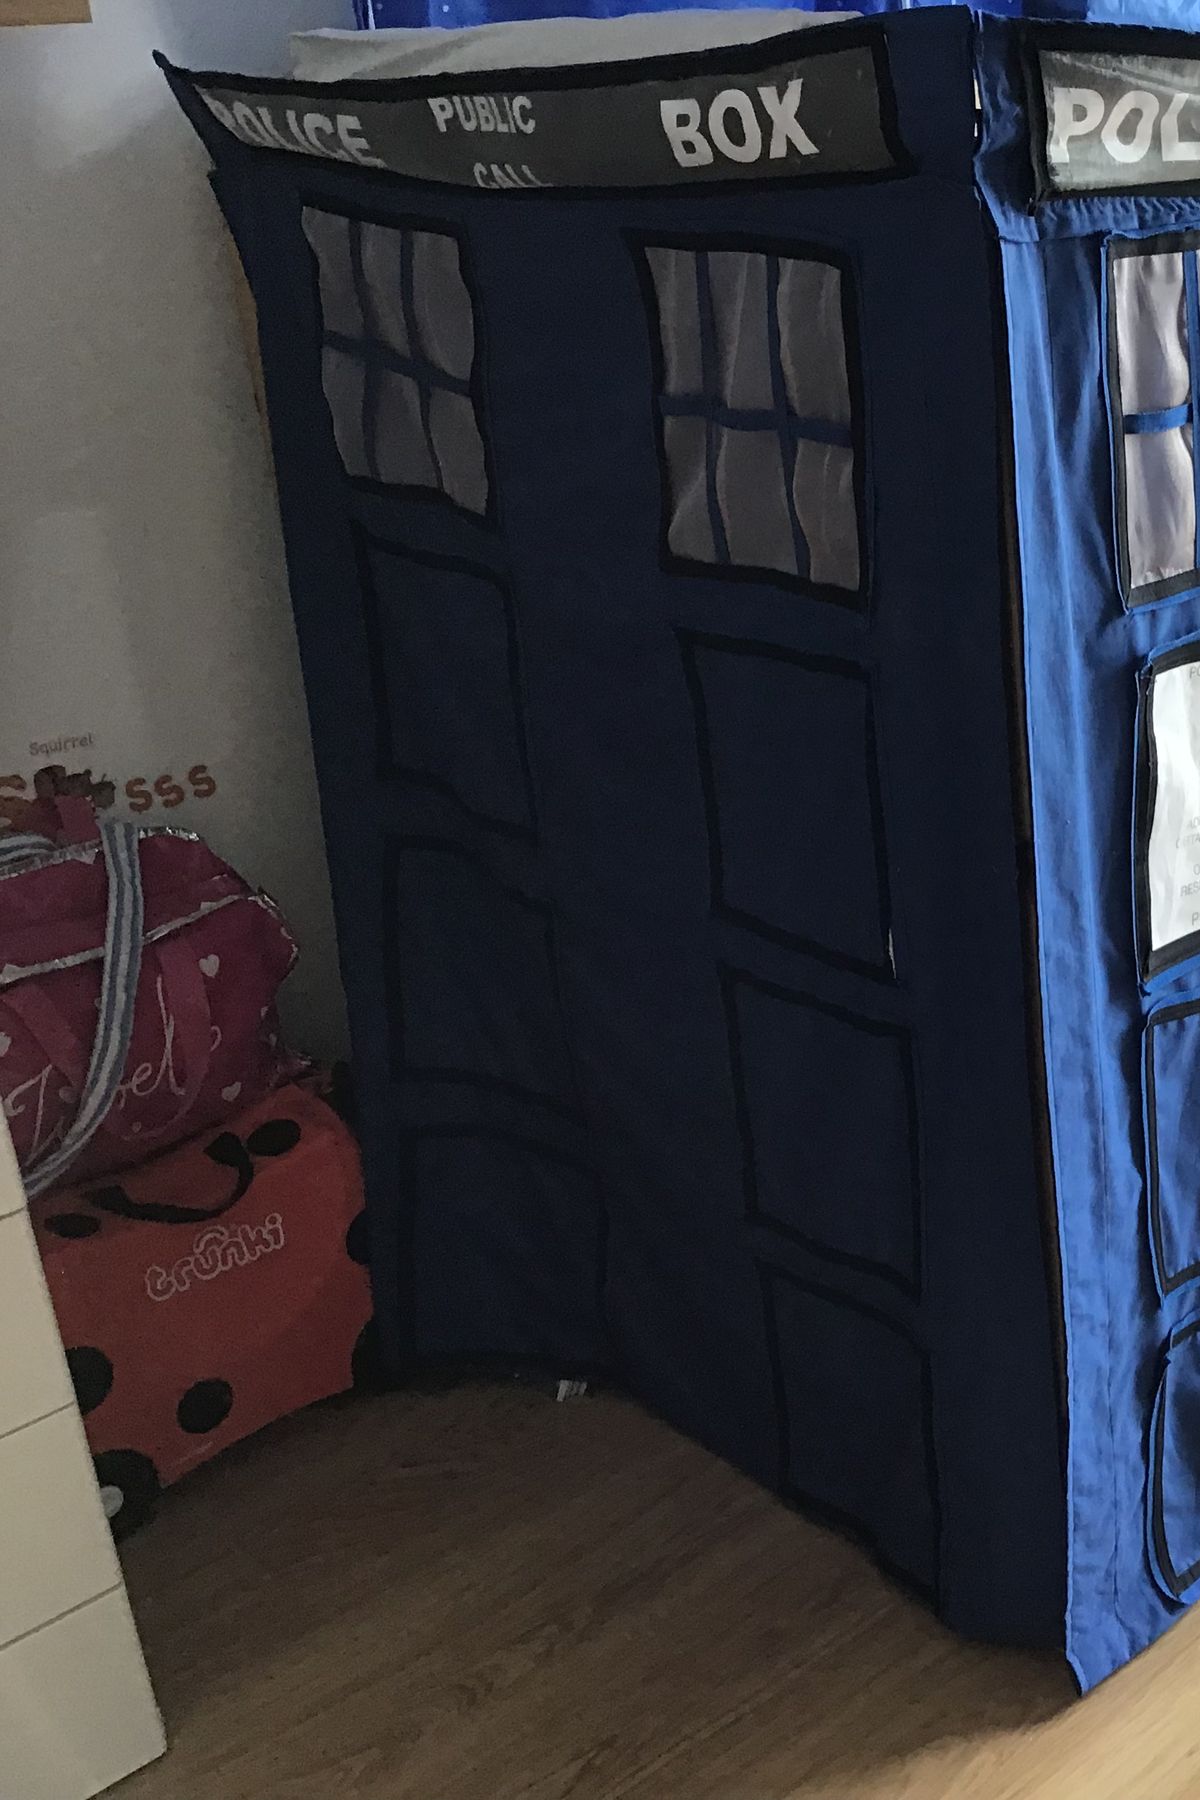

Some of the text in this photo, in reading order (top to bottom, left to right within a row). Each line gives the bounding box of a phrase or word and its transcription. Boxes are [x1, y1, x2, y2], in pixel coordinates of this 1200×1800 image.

[200, 90, 388, 168] POLICE
[427, 95, 536, 134] PUBLIC
[659, 79, 820, 169] BOX
[473, 162, 553, 189] CALL
[28, 732, 95, 758] Squirrel
[145, 1212, 284, 1302] trunki
